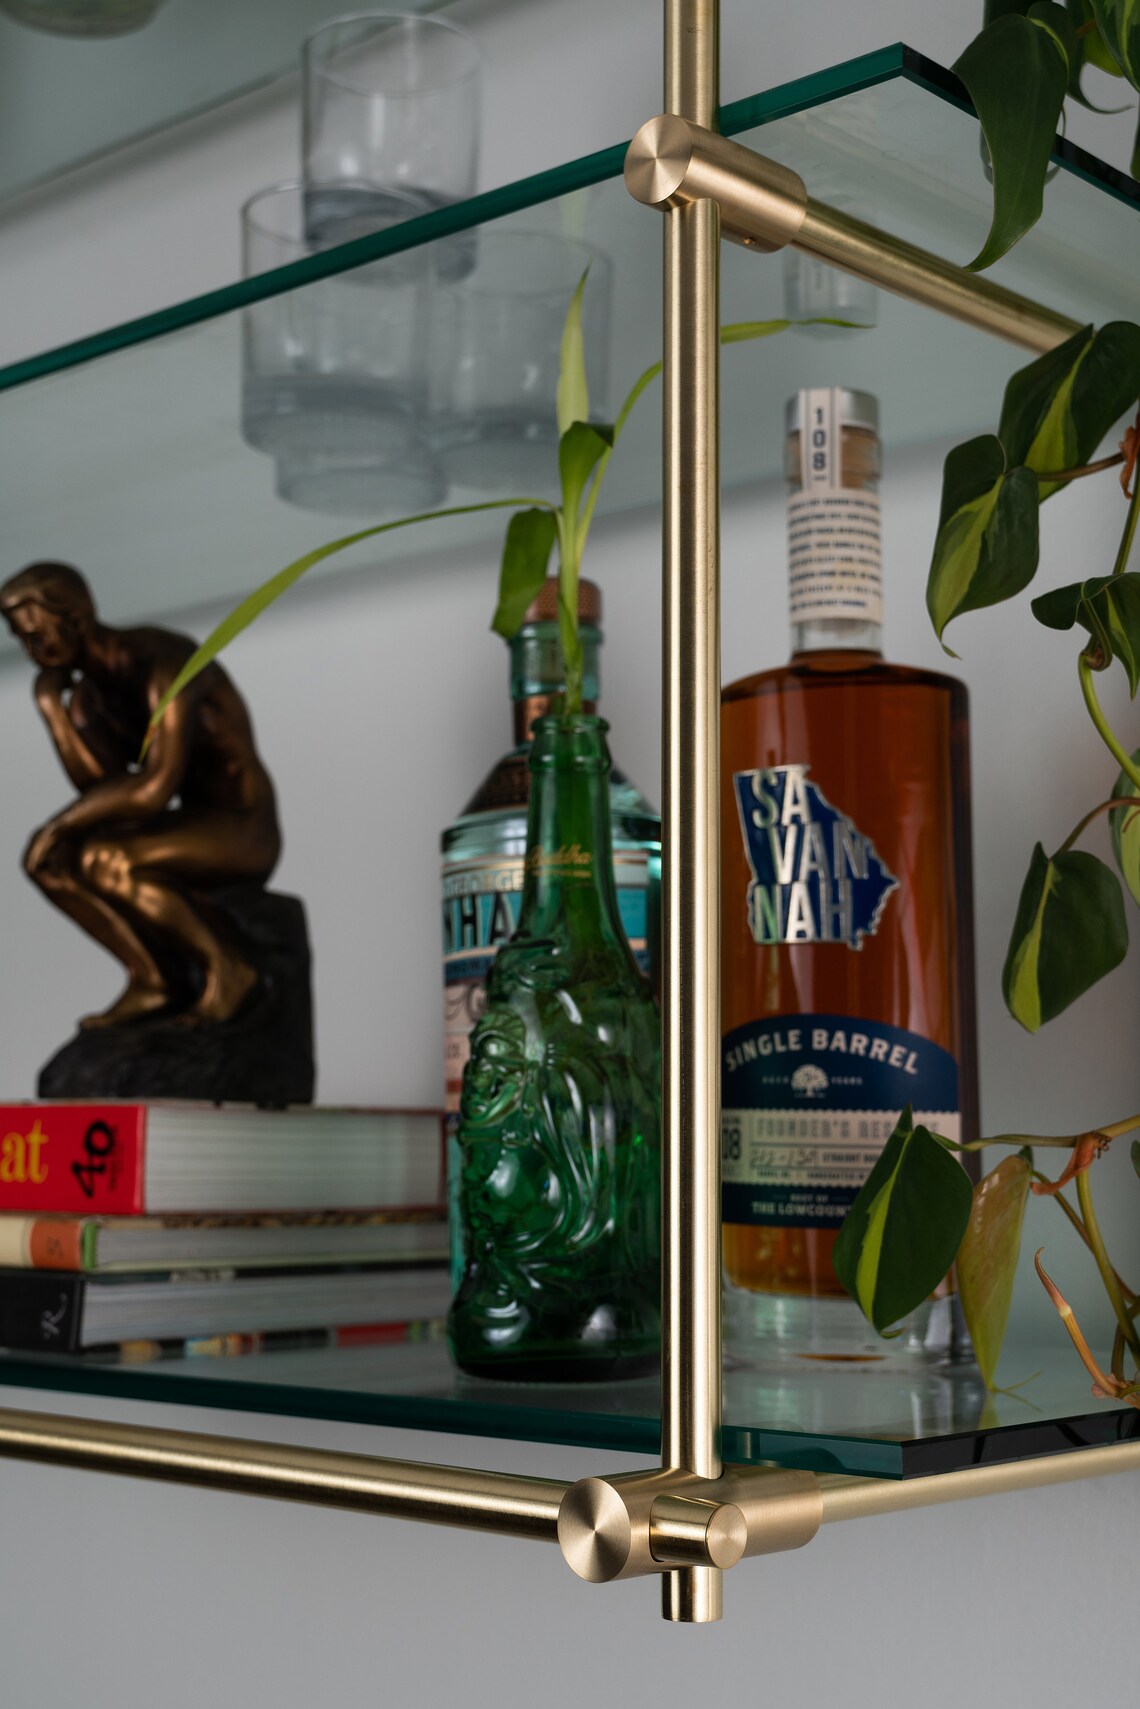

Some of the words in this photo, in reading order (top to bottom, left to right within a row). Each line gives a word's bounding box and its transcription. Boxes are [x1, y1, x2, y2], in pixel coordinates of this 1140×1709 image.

[811, 406, 828, 472] 108
[753, 880, 854, 945] NAH
[726, 1029, 802, 1071] SINGLE
[812, 1029, 919, 1074] BARREL
[751, 1201, 776, 1216] THE
